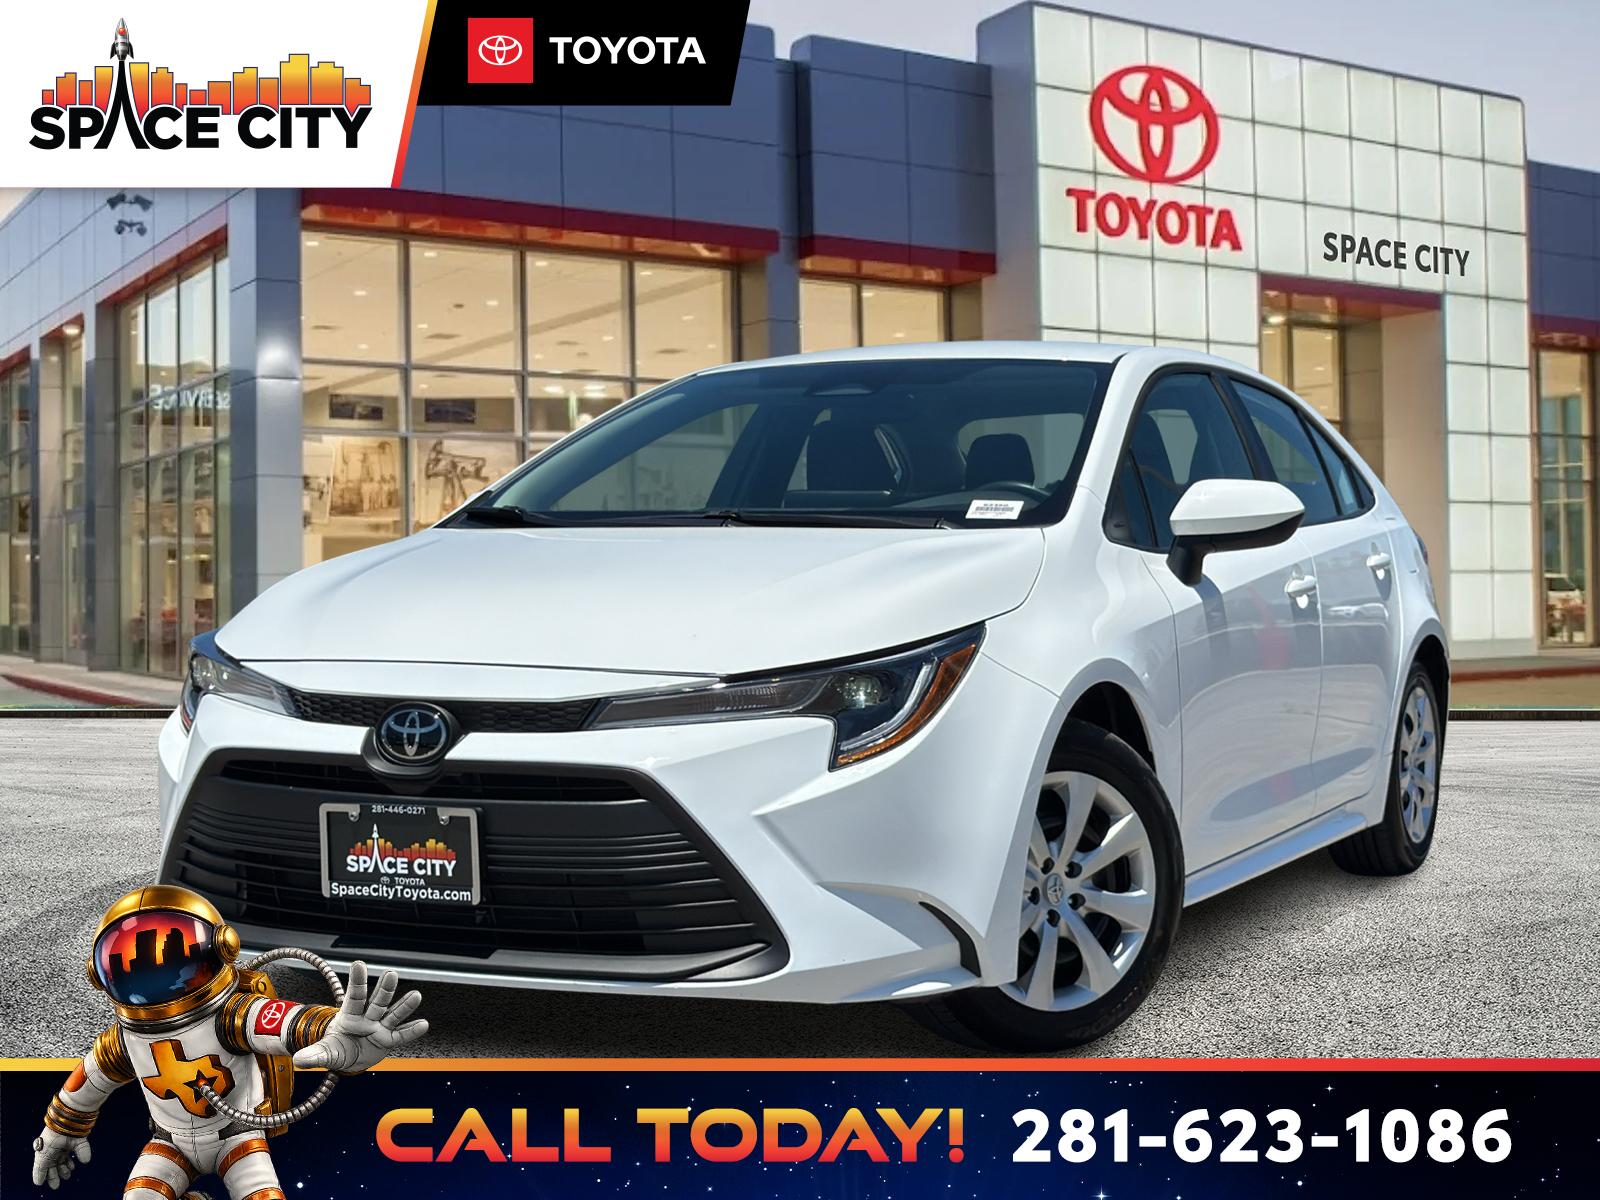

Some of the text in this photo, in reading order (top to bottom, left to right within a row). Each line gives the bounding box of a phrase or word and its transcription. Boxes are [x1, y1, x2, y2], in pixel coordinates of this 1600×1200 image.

[1066, 187, 1242, 251] TOYOTA
[1323, 231, 1470, 277] SPACE CITY
[371, 804, 426, 815] 281-446-0271
[346, 853, 457, 877] SPACE CITY
[331, 882, 471, 901] SpaceCityToyota.com
[394, 877, 426, 886] TOYOTA
